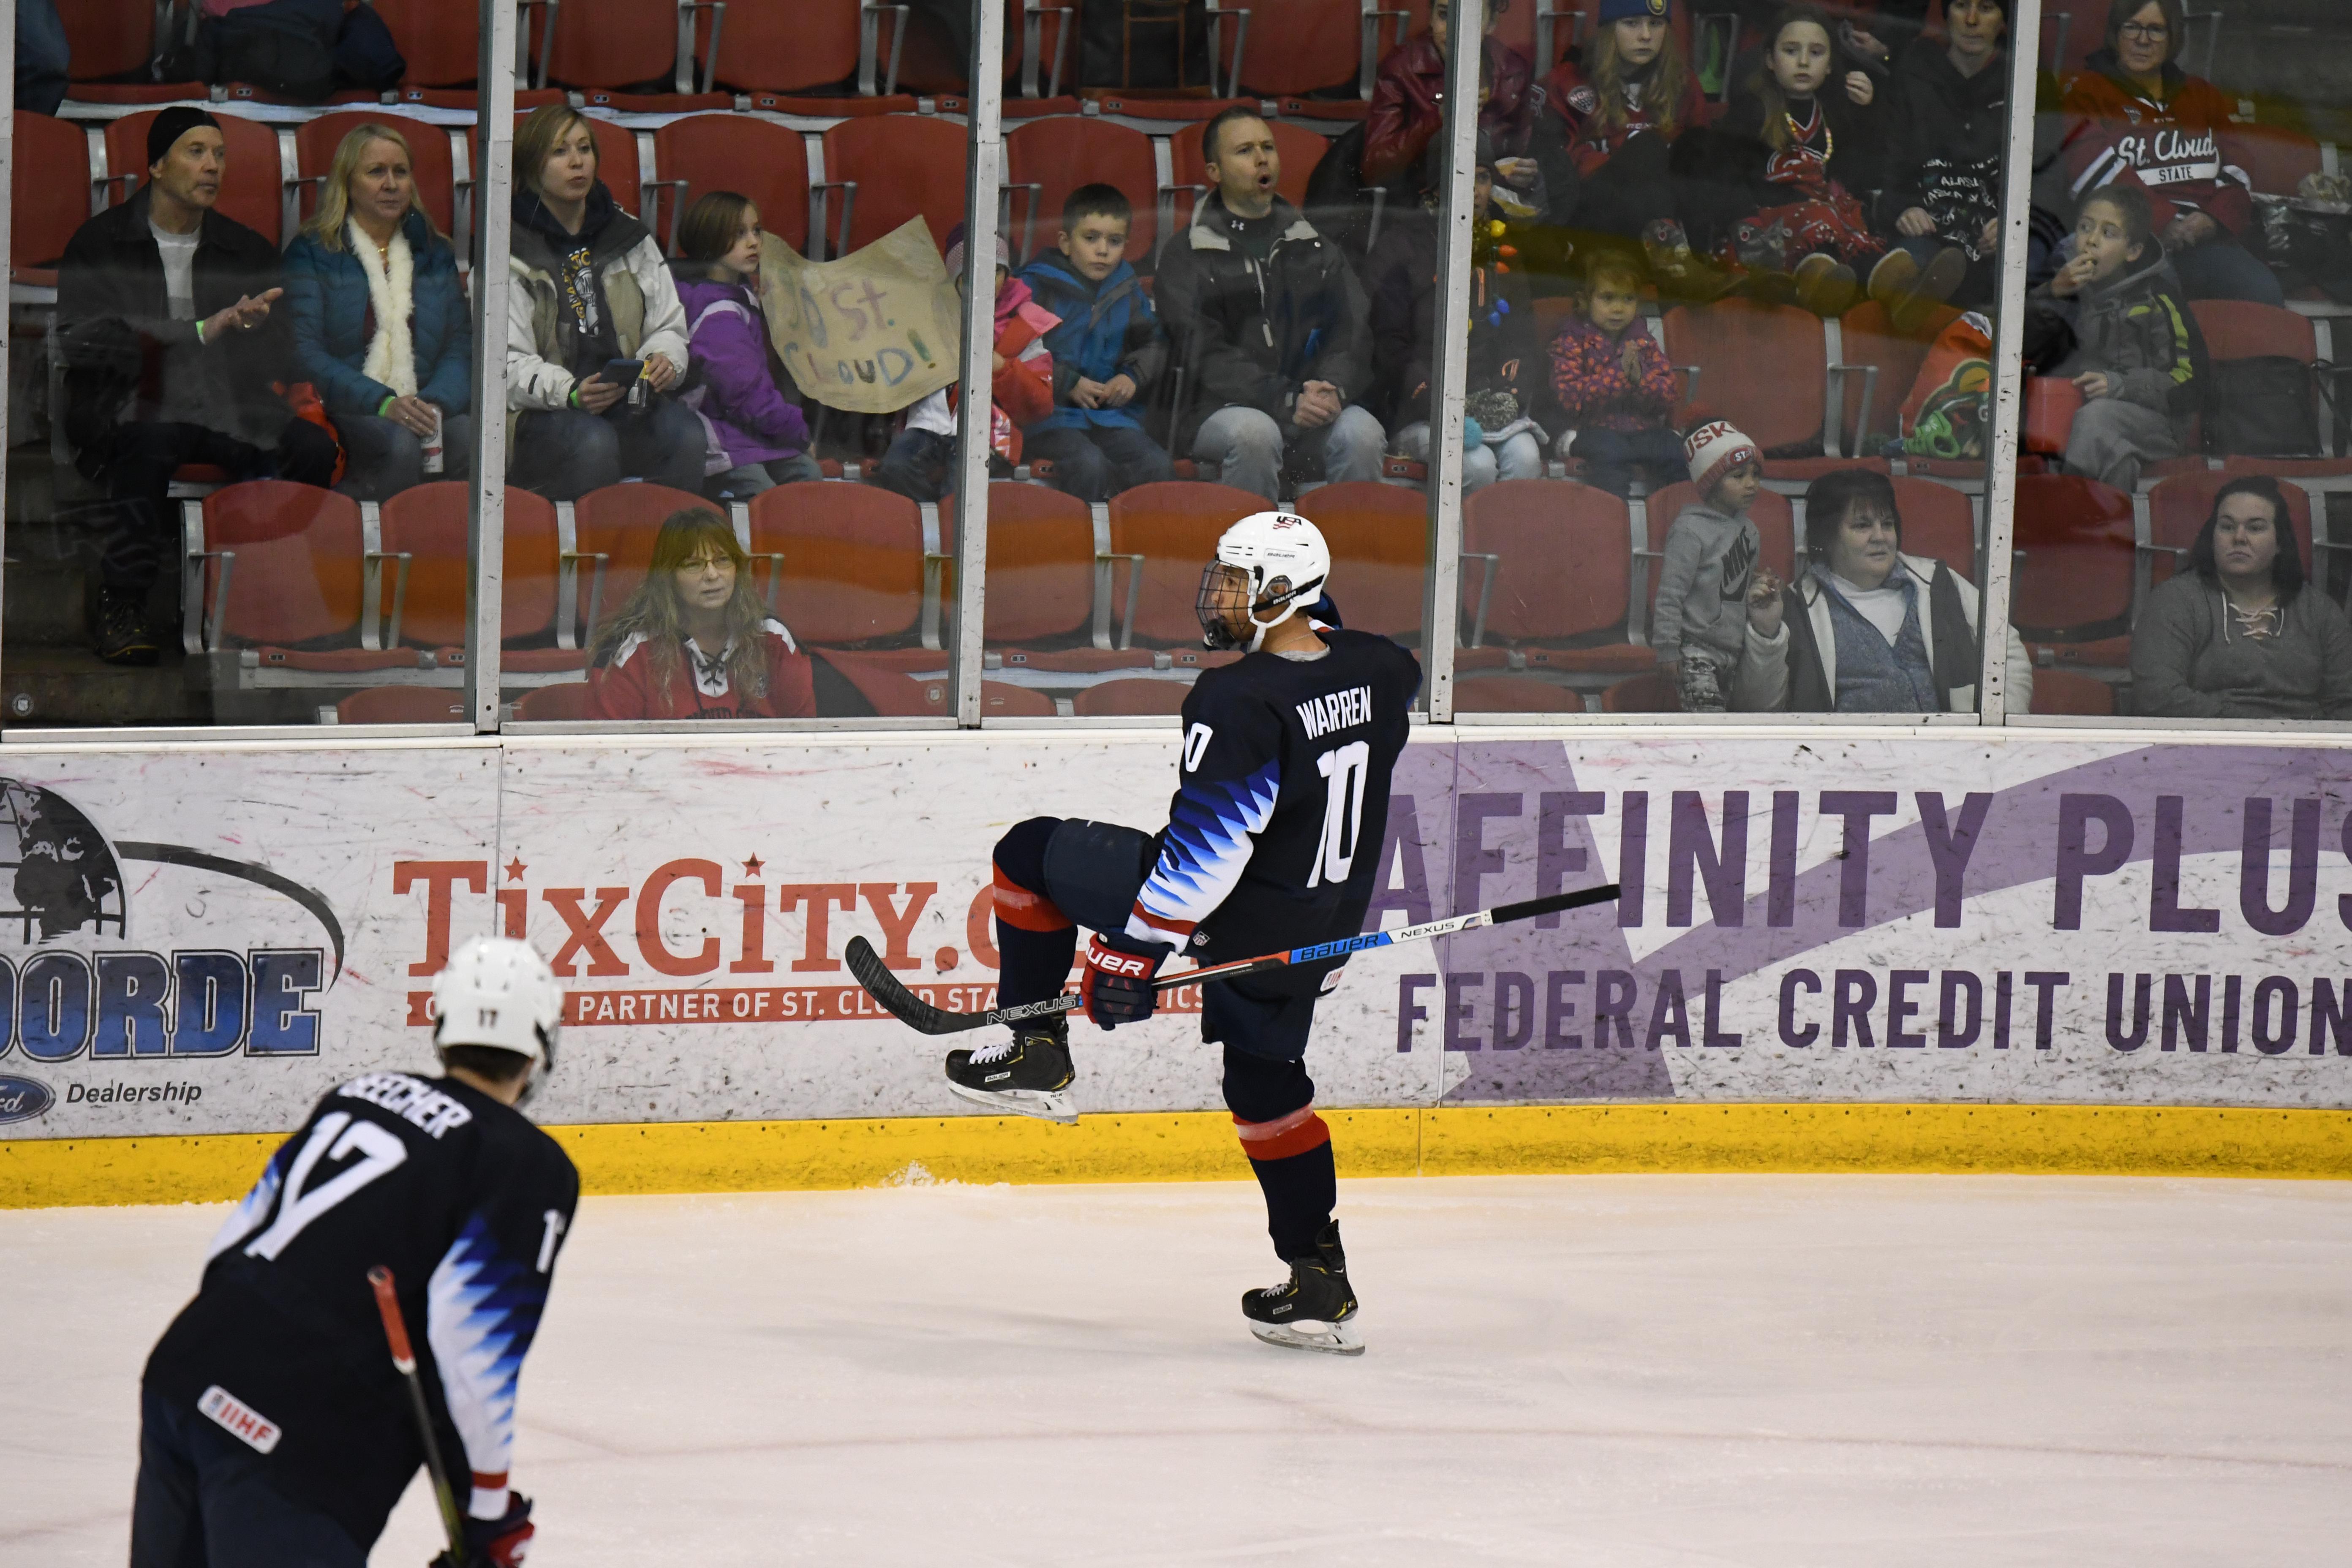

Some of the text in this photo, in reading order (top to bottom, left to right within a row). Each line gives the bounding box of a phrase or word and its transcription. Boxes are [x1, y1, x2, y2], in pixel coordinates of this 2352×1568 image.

[2118, 127, 2218, 166] St. Cloud
[2159, 166, 2193, 182] STATE
[1721, 525, 1756, 587] NIKE
[1273, 591, 1297, 605] BAUER
[1296, 686, 1371, 740] WARREN
[1185, 722, 1213, 772] 0
[1306, 740, 1369, 888] 10
[1359, 790, 2352, 936] AFFINITY PLU
[1301, 921, 1455, 961] BAUER NEXUS
[1086, 947, 1145, 976] UER
[479, 1009, 498, 1028] 17
[579, 993, 720, 1021] PARTNER
[732, 992, 770, 1017] OF
[781, 991, 825, 1016] ST.
[947, 987, 999, 1013] STA
[986, 995, 1076, 1025] NEXUS
[1396, 969, 2352, 1056] FEDERAL CREDIT UNION
[66, 1082, 202, 1106] Dealership
[244, 1111, 408, 1262] 17
[219, 1402, 272, 1442] IIHF
